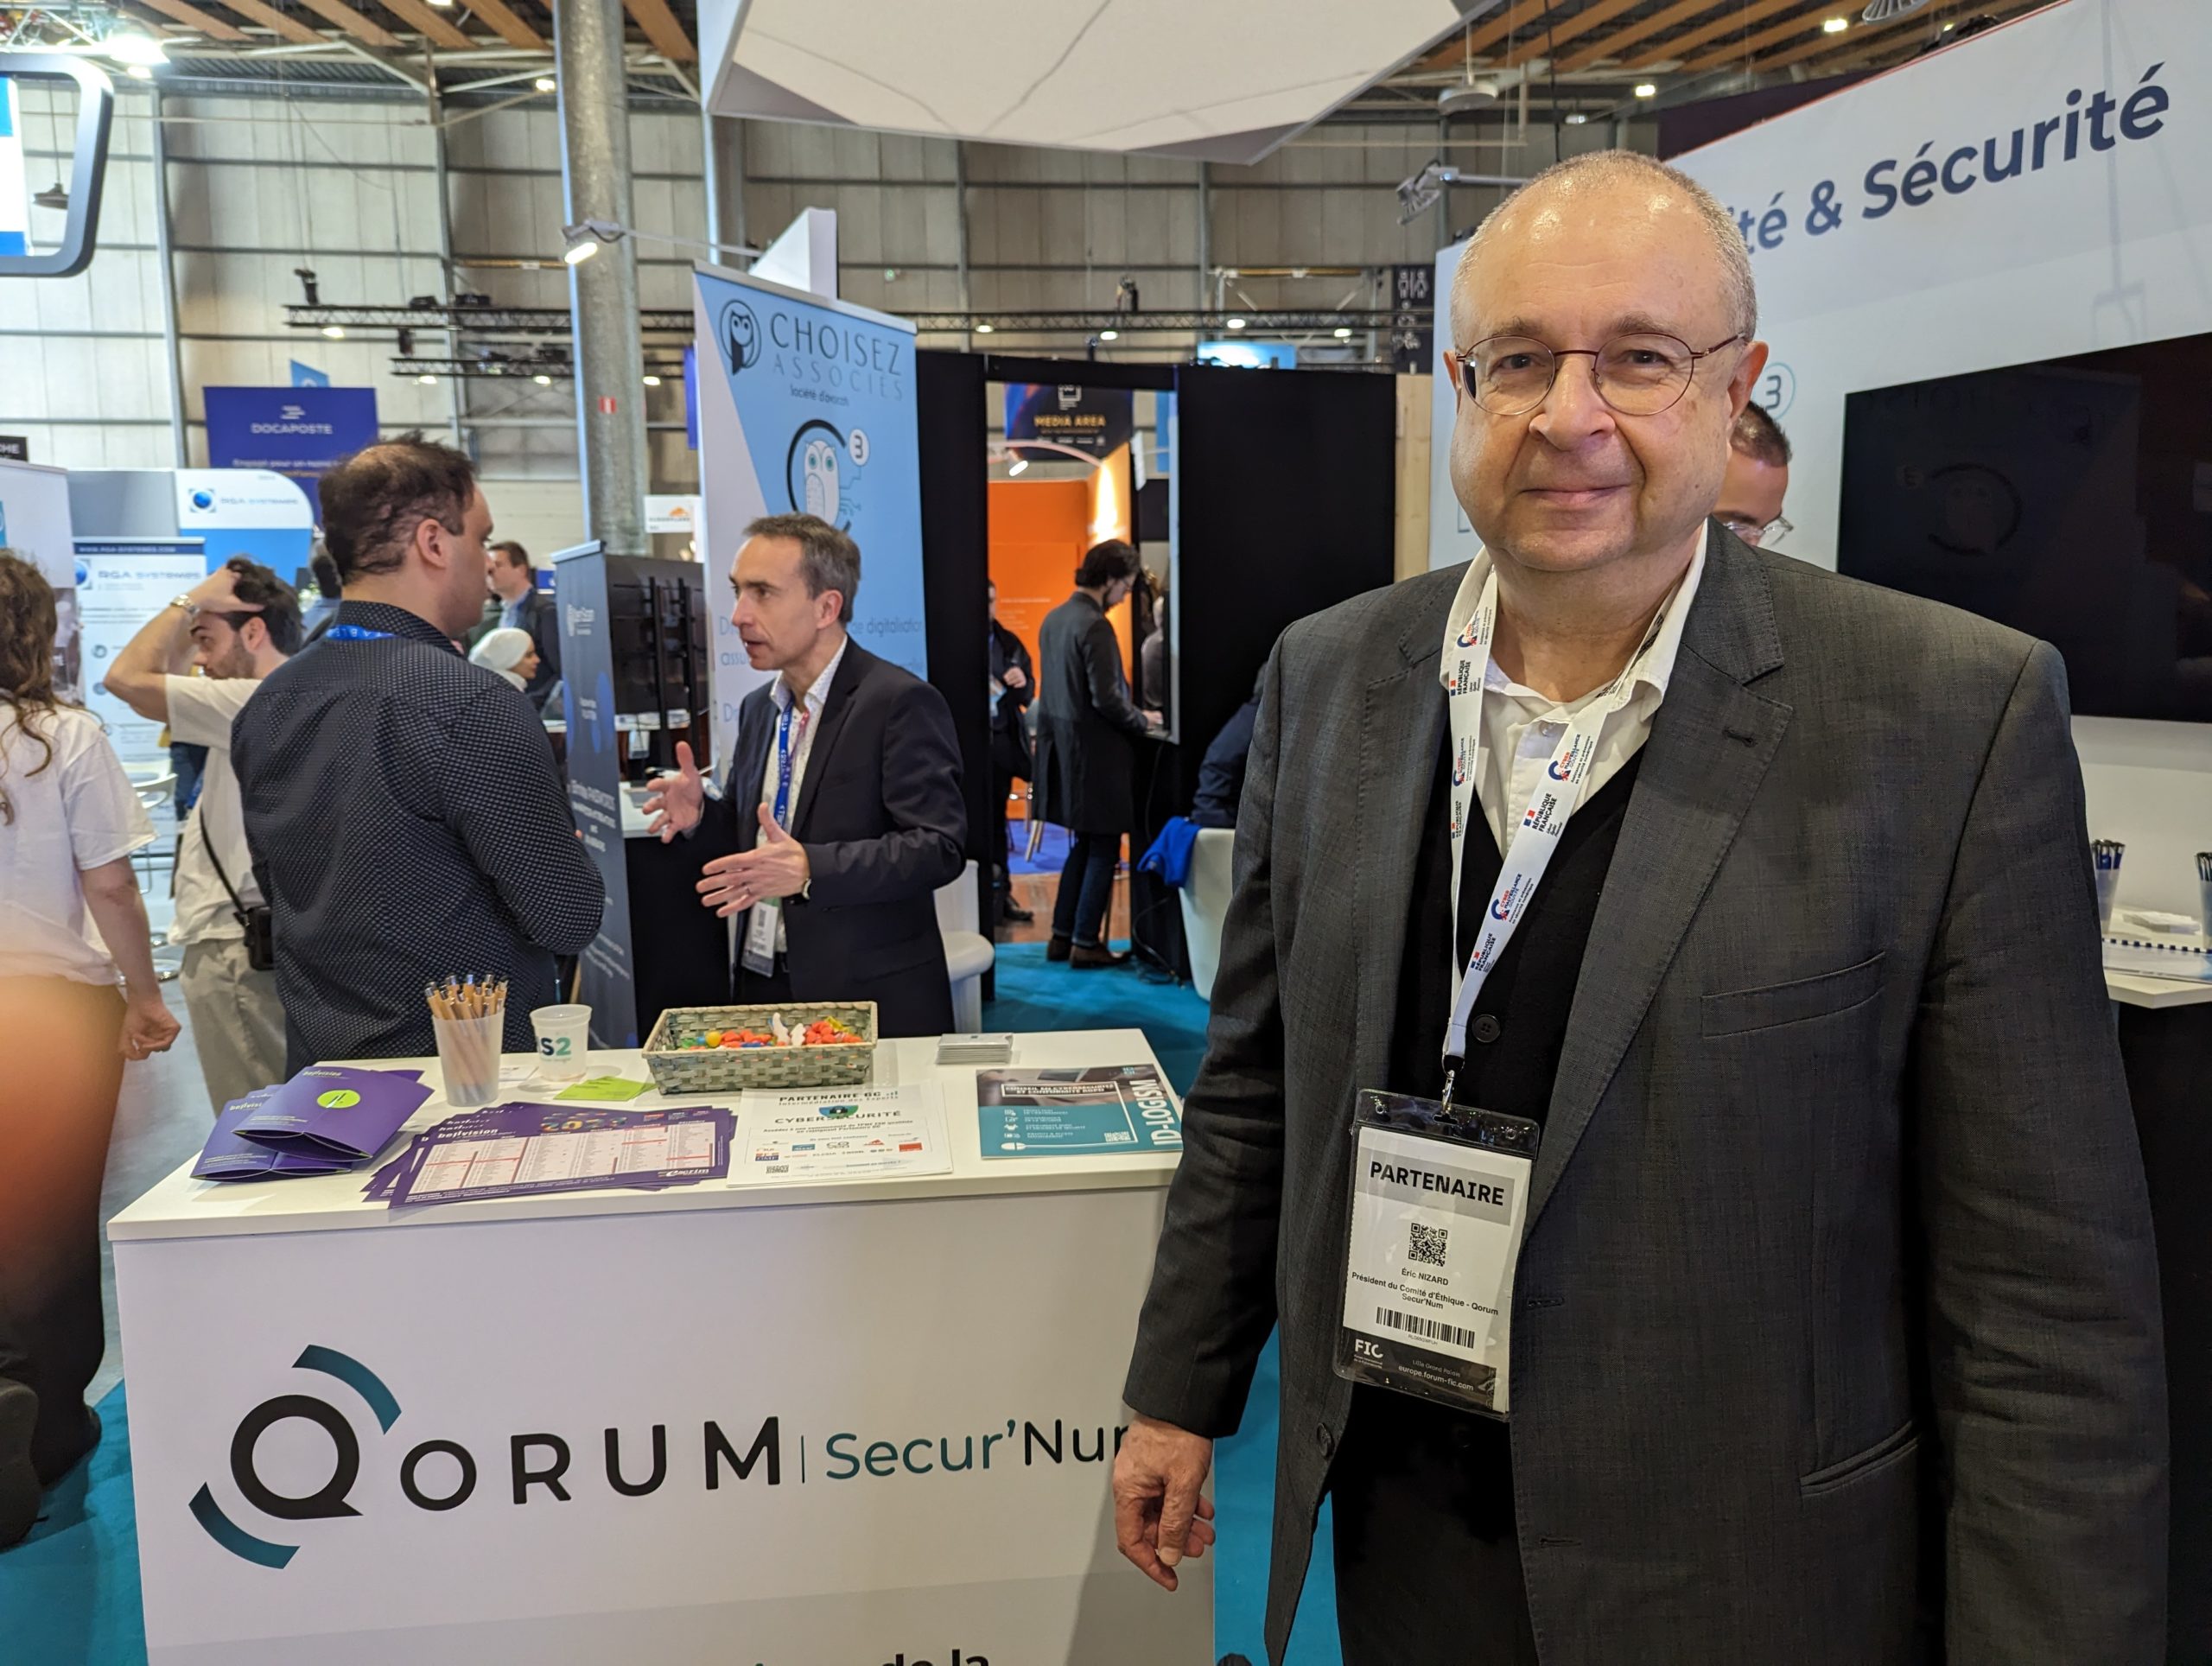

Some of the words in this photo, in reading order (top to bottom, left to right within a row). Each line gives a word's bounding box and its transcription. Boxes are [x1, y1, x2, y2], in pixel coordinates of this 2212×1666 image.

[1727, 190, 1788, 254] té
[1805, 180, 1842, 236] &
[1862, 62, 2170, 219] Sécurité
[771, 312, 901, 376] CHOISEZ
[251, 423, 333, 434] DOCAPOSTE
[1034, 414, 1071, 427] MEDIA
[1074, 415, 1106, 427] AREA
[853, 435, 865, 459] 3
[1531, 792, 1552, 830] RÉPUBLIQUE
[1539, 798, 1558, 832] FRANÇAISE
[1475, 932, 1492, 970] RÉPUBLIQUE
[1478, 938, 1496, 971] FRANÇAISE
[541, 1037, 571, 1056] S2
[779, 1092, 860, 1102] PARTENAIRE
[1129, 1078, 1183, 1146] ID-LOGISM
[1370, 1160, 1504, 1206] PARTENAIRE
[1402, 1268, 1416, 1278] Éric
[1418, 1272, 1449, 1286] NIZARD
[1351, 1272, 1386, 1287] Président
[1388, 1281, 1397, 1290] du
[1400, 1284, 1427, 1297] Comité
[1428, 1292, 1465, 1307] d'Éthique
[1471, 1302, 1498, 1315] Qorum
[1402, 1294, 1444, 1309] Secur'Num
[1355, 1339, 1384, 1358] FIC
[1398, 1365, 1474, 1391] europe.forum-fic.com
